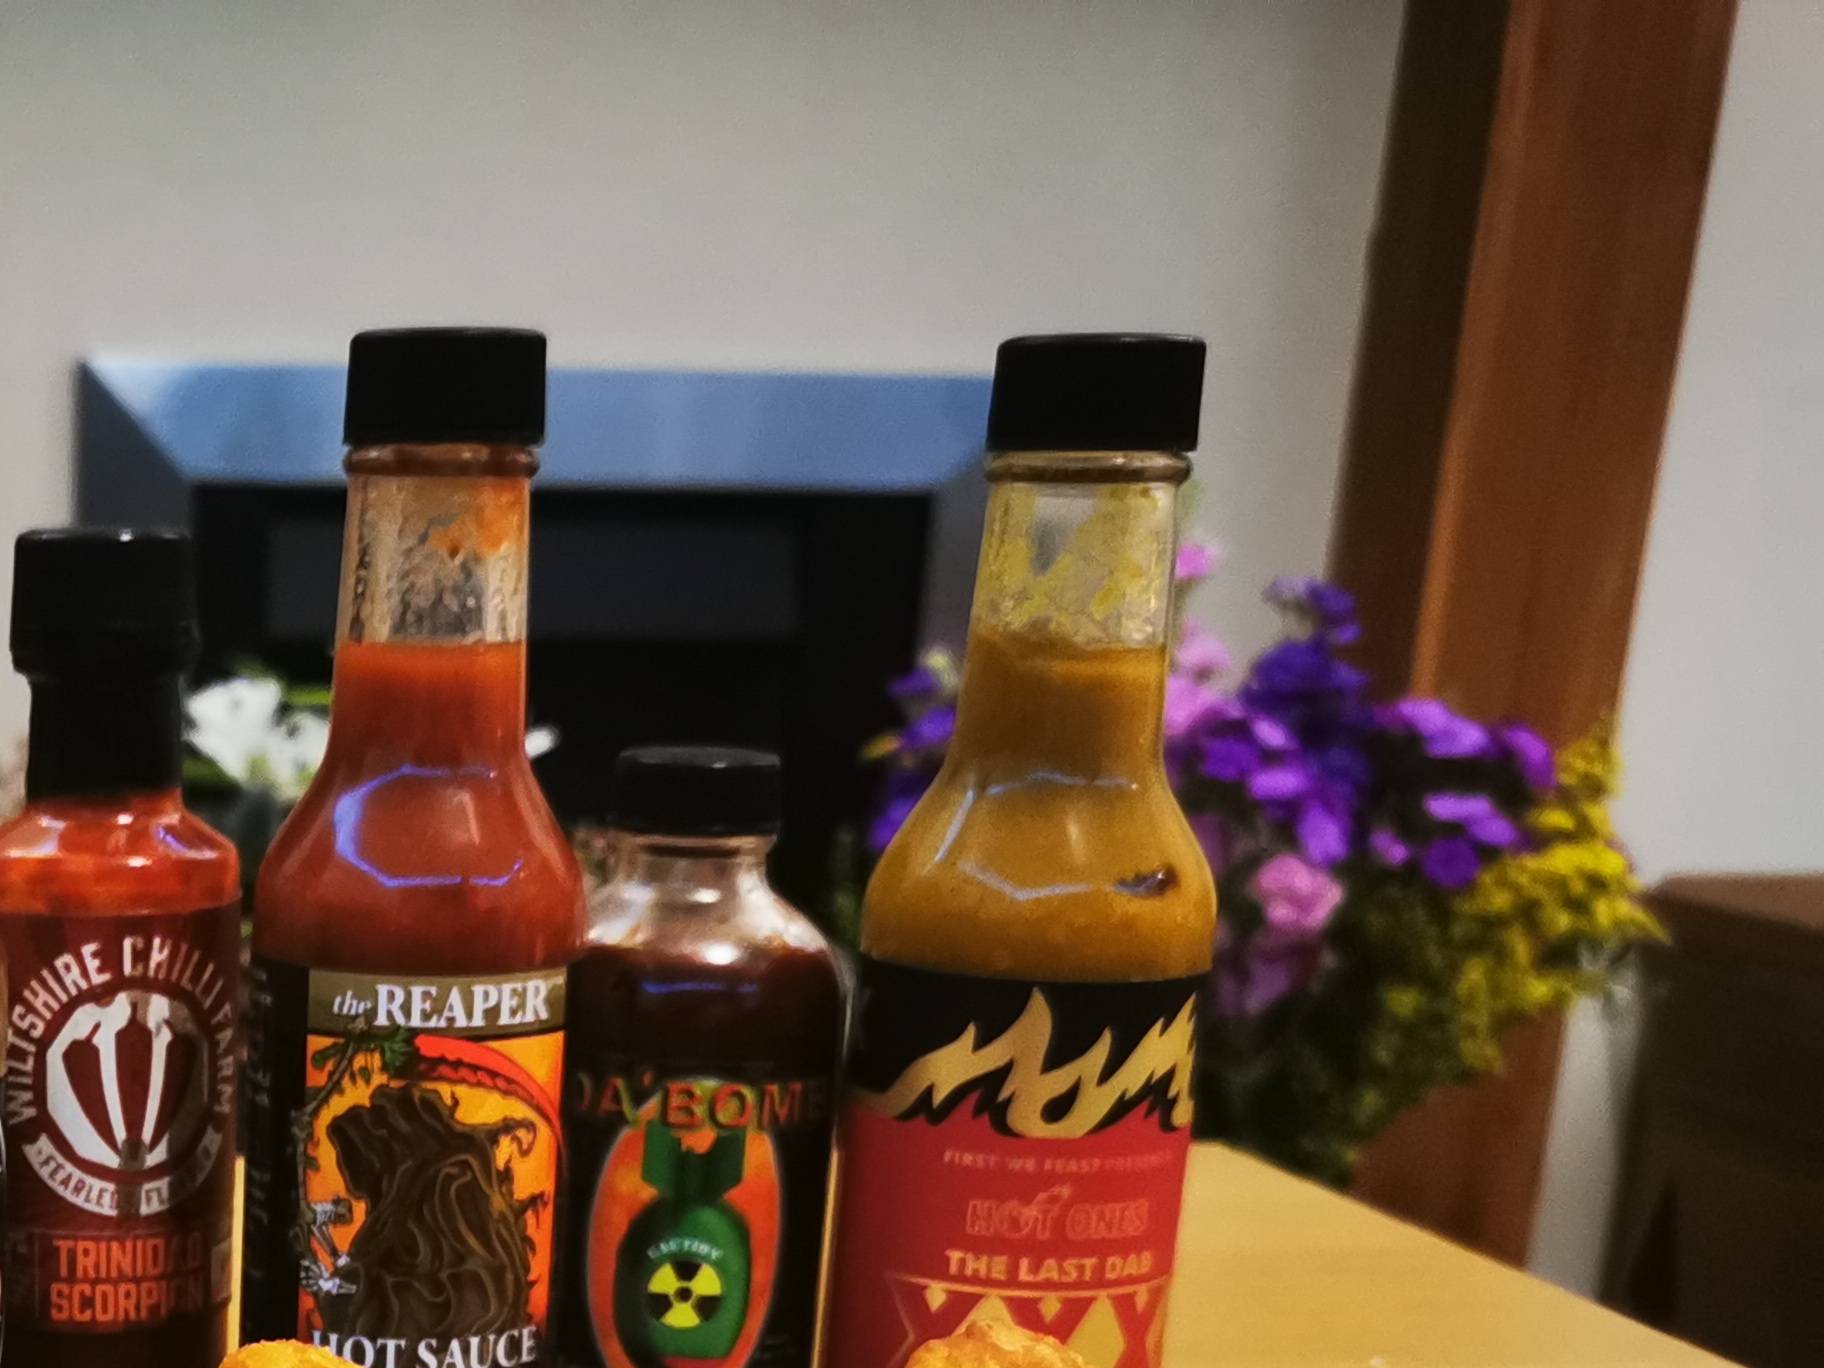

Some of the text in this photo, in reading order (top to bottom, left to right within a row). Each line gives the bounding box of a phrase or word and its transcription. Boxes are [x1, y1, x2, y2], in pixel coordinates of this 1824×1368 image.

[332, 978, 552, 1029] the REAPER
[7, 941, 113, 1126] WILTSHIRE
[943, 1248, 1154, 1283] THE LAST DAB
